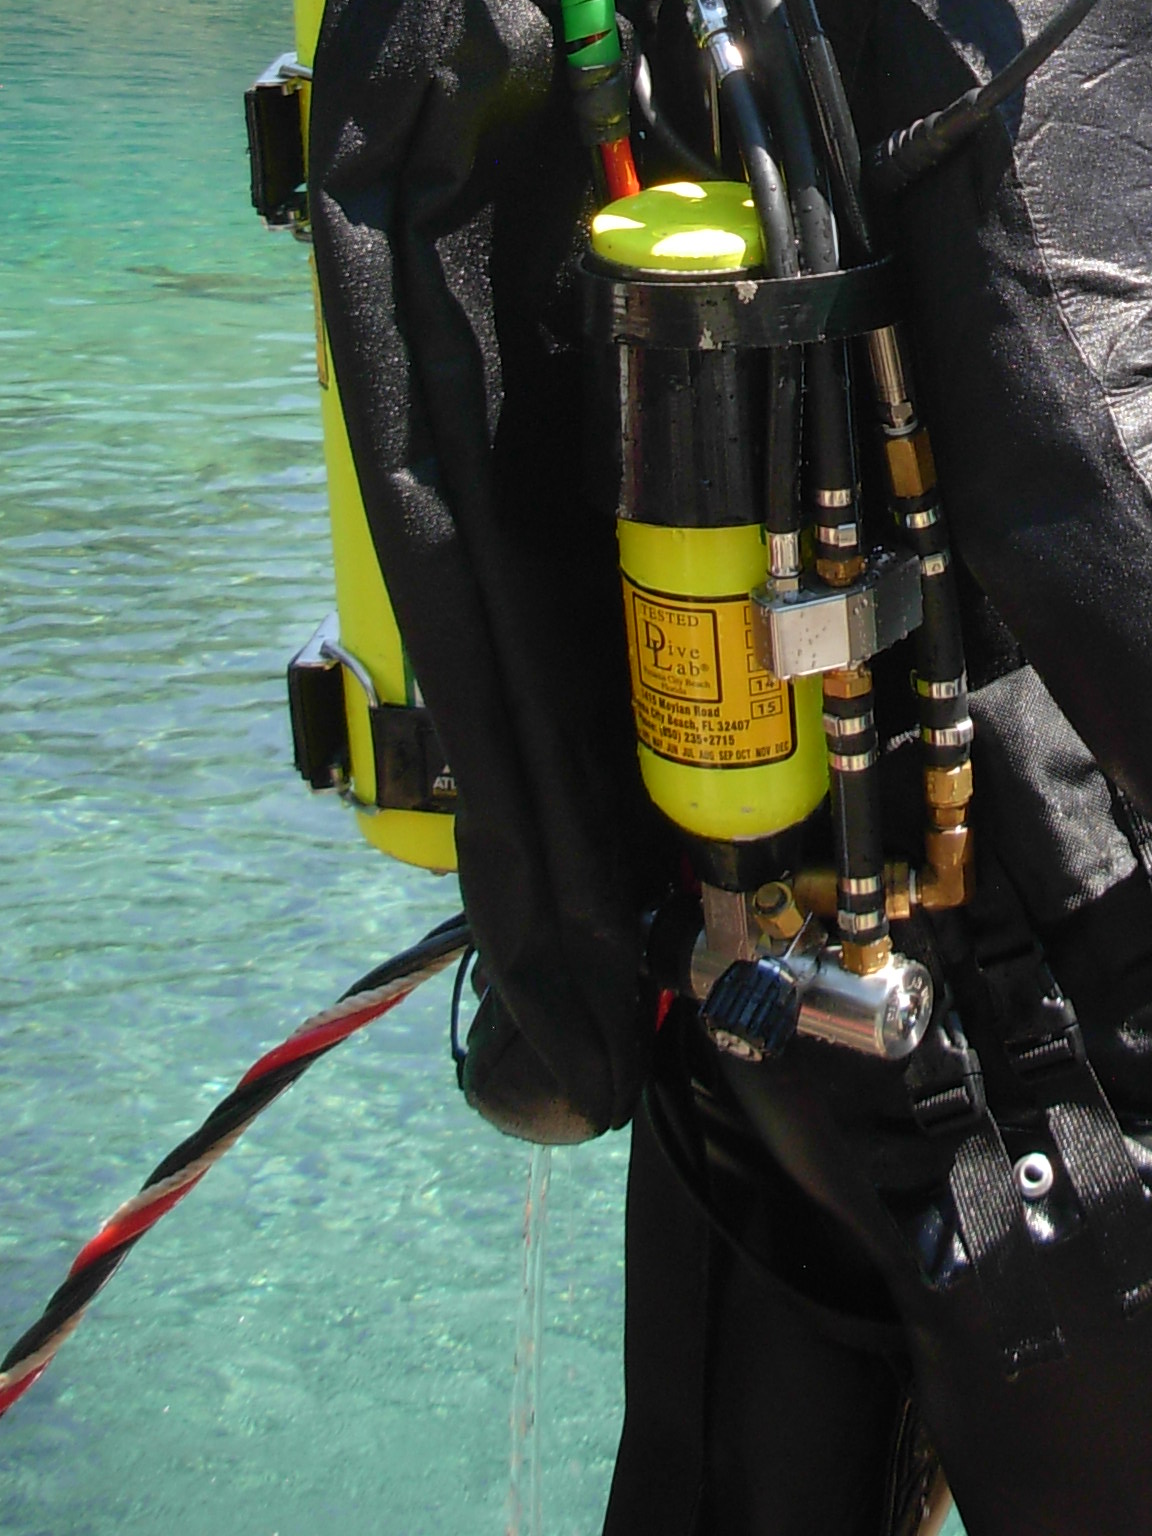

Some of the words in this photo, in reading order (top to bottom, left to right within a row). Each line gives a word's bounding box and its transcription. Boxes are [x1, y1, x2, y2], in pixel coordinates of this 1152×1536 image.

[641, 603, 699, 627] TESTED
[643, 618, 700, 659] Dive
[694, 705, 720, 718] Road
[757, 701, 775, 715] 15
[702, 721, 714, 732] FL
[717, 720, 750, 732] 32407
[719, 750, 734, 761] SEP
[736, 748, 752, 759] OCT
[755, 746, 771, 758] NOV
